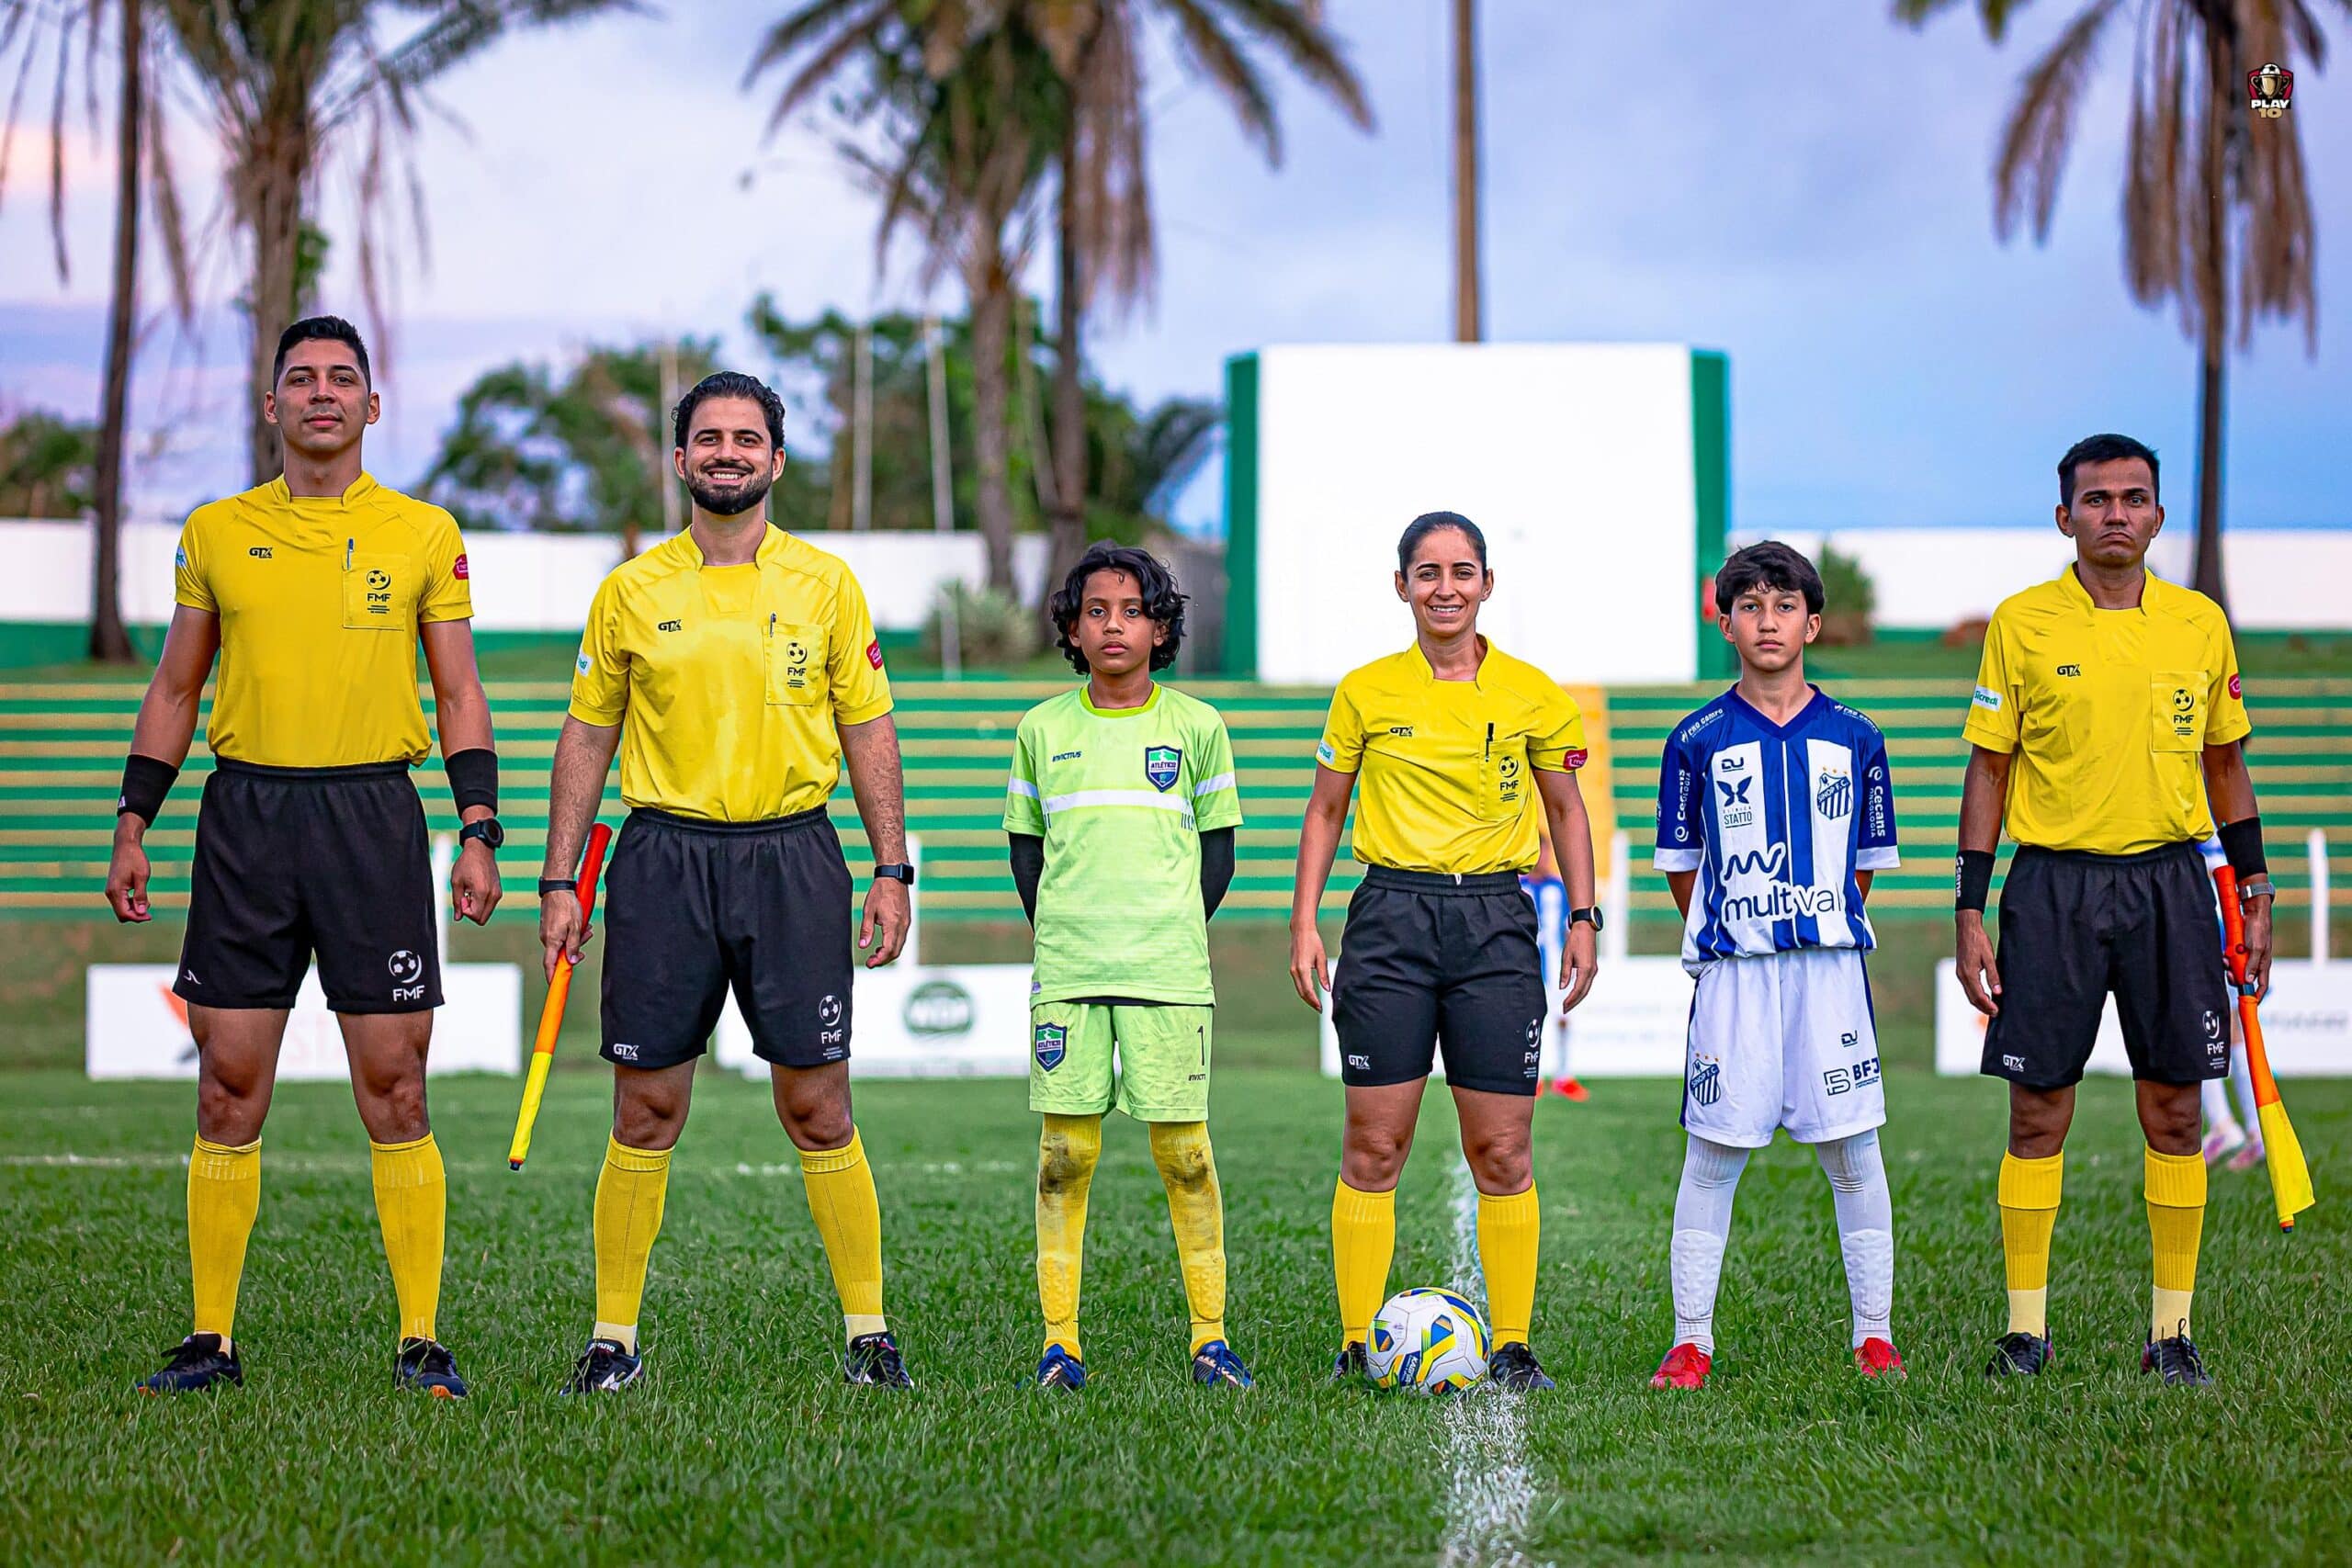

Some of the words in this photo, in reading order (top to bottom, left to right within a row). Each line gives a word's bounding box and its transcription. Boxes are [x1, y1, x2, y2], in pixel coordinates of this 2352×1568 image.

[249, 547, 273, 558] GTX
[367, 592, 391, 603] FMF
[658, 618, 683, 632] GTX
[786, 667, 806, 677] FMF
[2056, 664, 2081, 677] GTX
[2174, 715, 2194, 724] FMF
[1390, 727, 1414, 738] GTX
[1499, 780, 1519, 791] FMF
[1724, 811, 1753, 825] STATTO
[392, 985, 425, 1001] FMF
[821, 1029, 842, 1044] FMF
[613, 1043, 639, 1057] GTX
[2207, 1042, 2225, 1055] FMF
[1349, 1055, 1370, 1067] GTX
[2003, 1055, 2026, 1069] GTX
